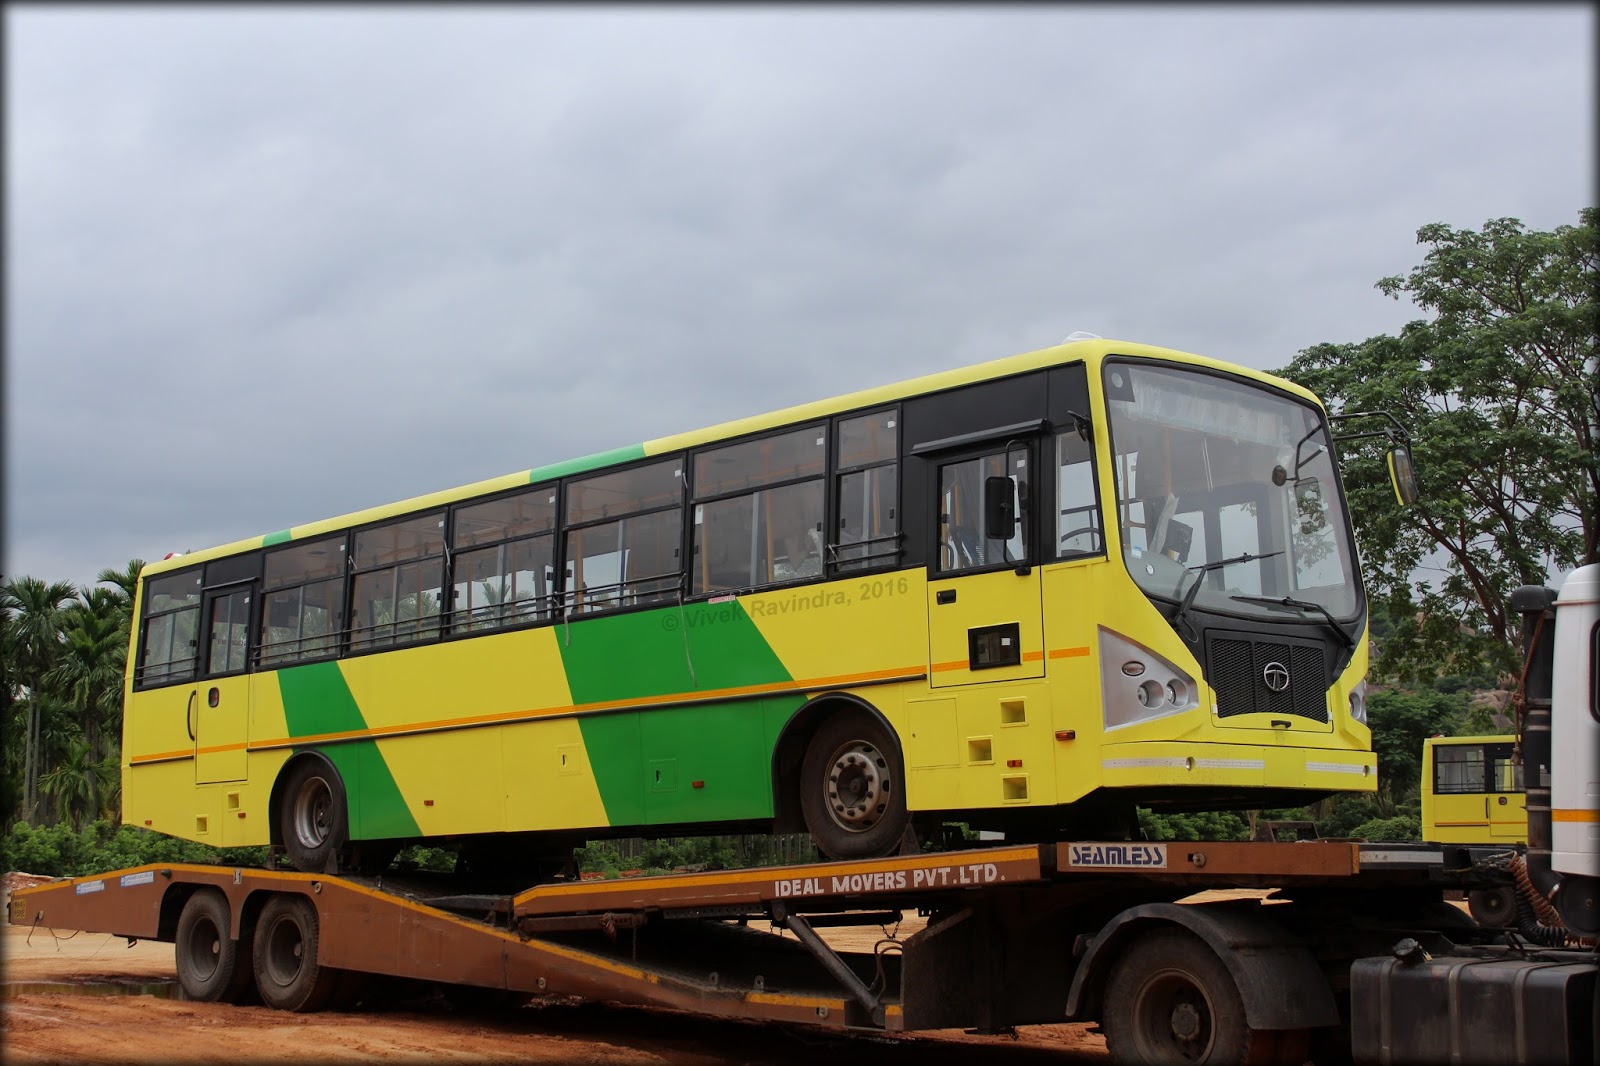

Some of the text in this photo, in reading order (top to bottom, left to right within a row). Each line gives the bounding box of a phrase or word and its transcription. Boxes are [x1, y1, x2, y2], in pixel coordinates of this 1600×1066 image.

[1072, 846, 1163, 865] SEAMLESS
[774, 880, 825, 897] IDEAL
[832, 871, 907, 893] MOVERS
